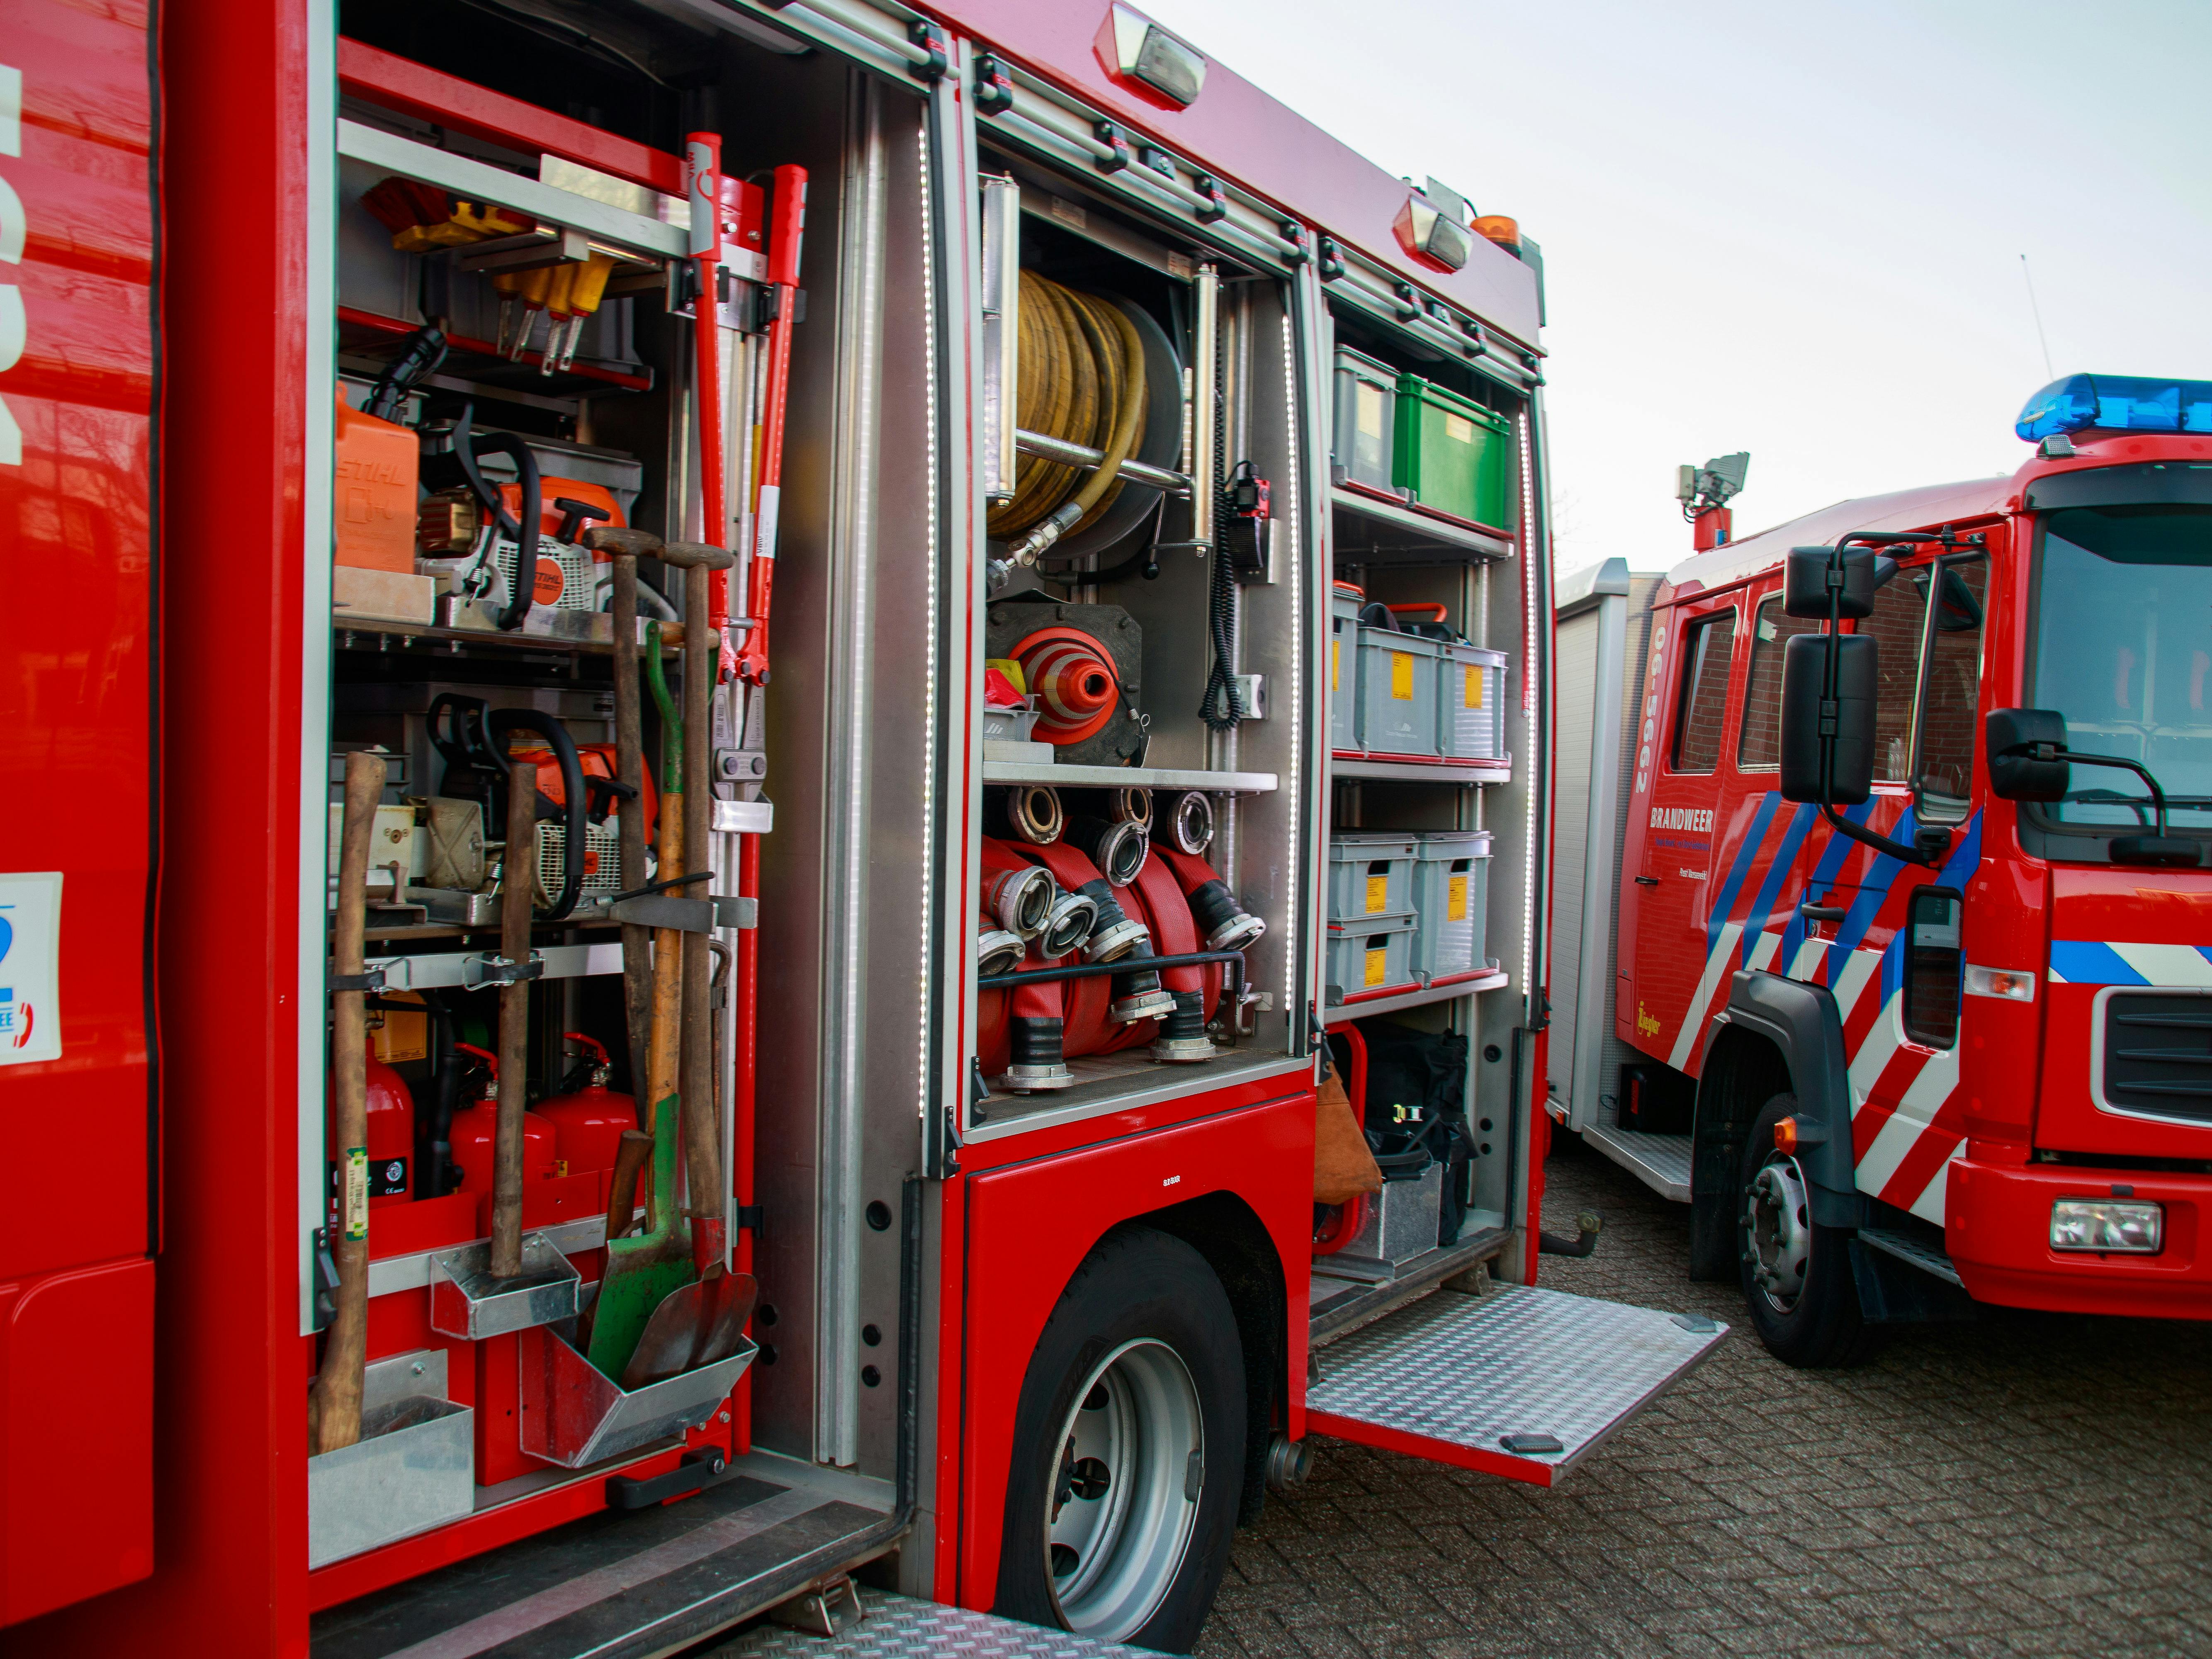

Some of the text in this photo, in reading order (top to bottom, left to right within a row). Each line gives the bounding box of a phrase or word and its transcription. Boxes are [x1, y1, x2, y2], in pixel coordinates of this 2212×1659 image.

[336, 460, 406, 486] STIHL
[534, 572, 561, 584] TIHL
[1635, 626, 1666, 793] 06-5662
[1650, 807, 1713, 832] BRANDWEER
